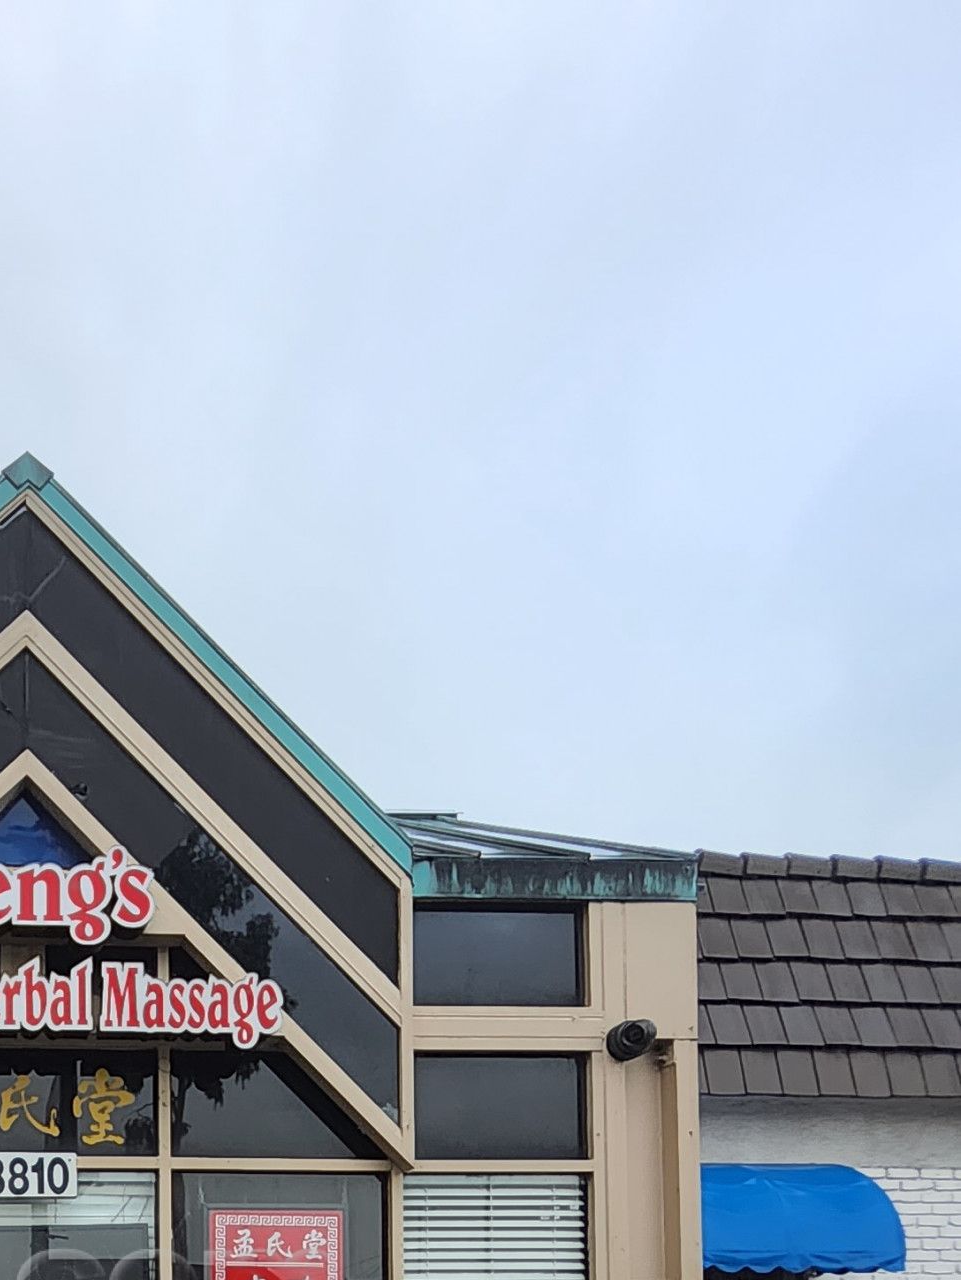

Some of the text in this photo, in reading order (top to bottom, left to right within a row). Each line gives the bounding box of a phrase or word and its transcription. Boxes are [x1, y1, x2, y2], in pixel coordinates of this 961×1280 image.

[103, 964, 280, 1045] Massage
[230, 1229, 327, 1260] 孟氏堂
